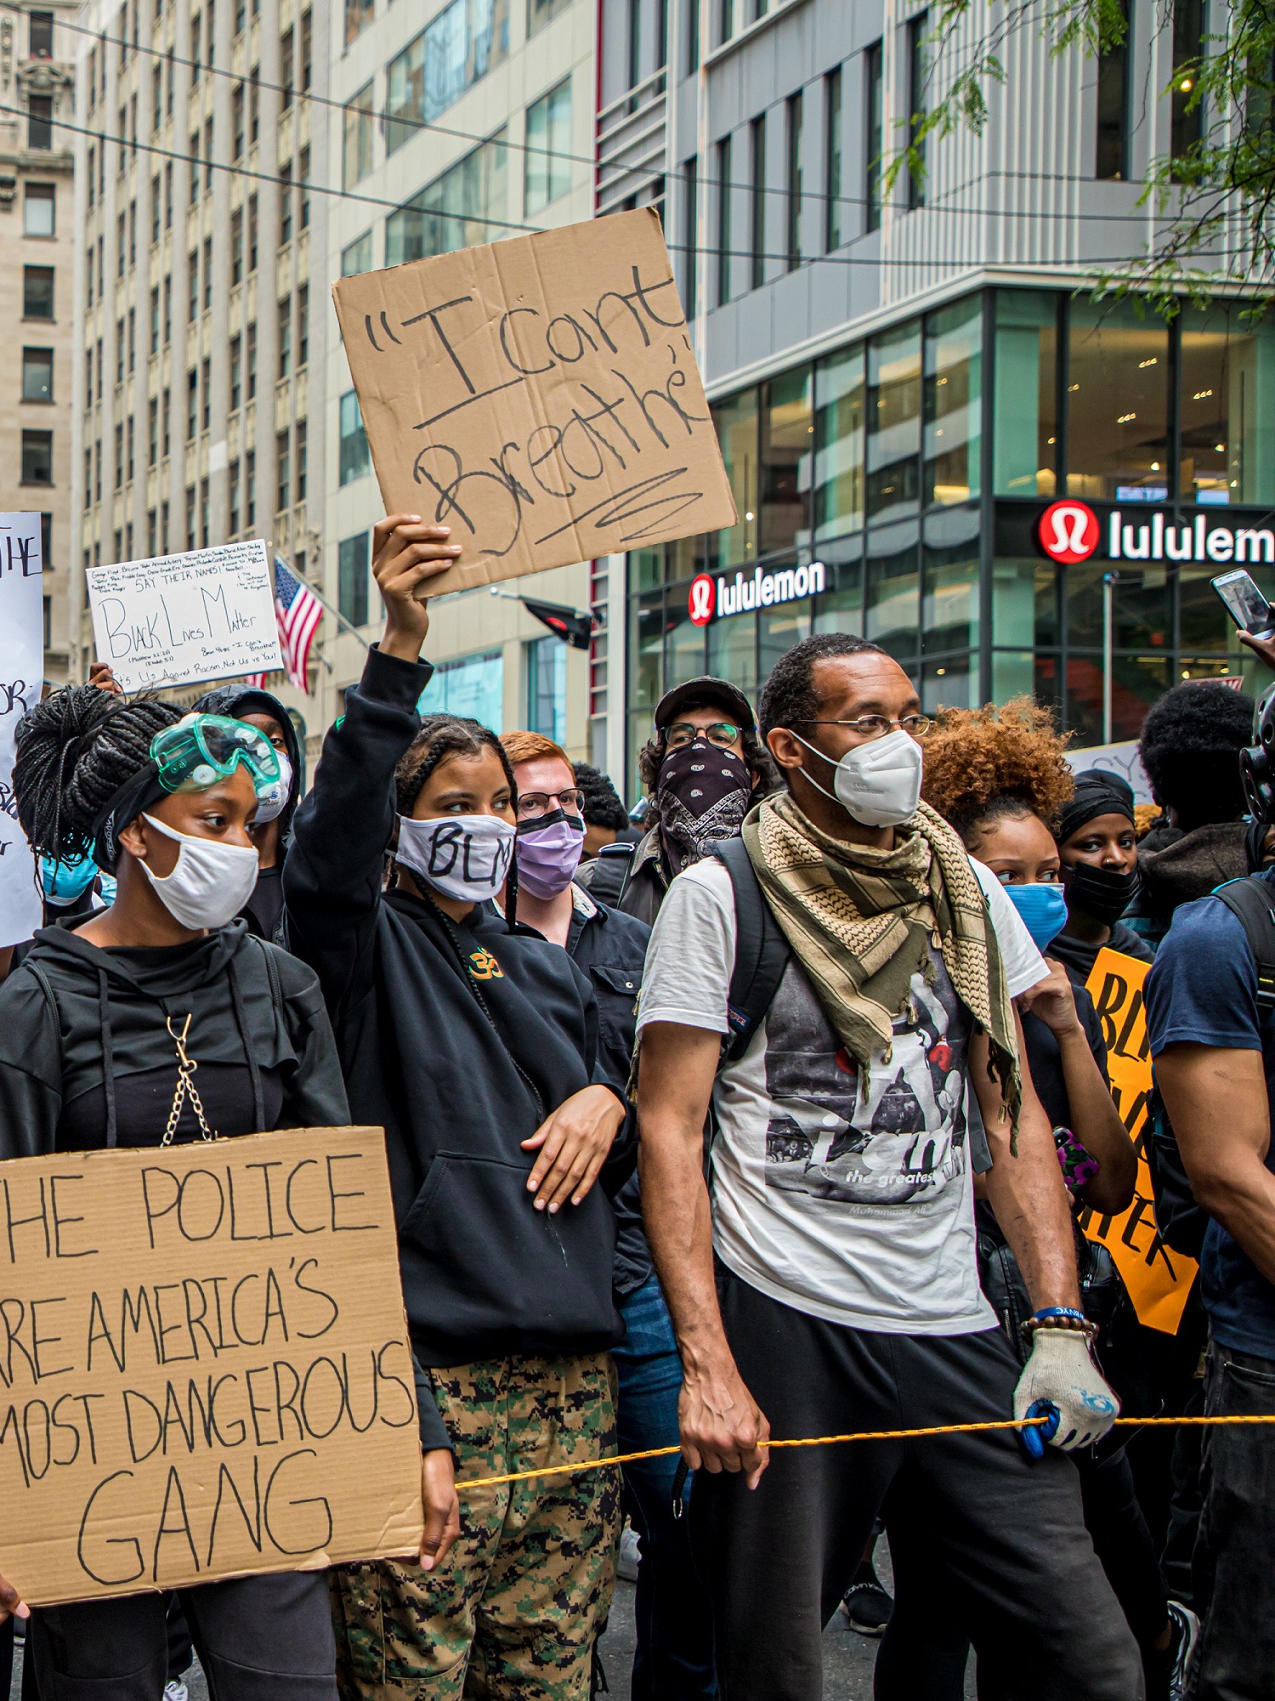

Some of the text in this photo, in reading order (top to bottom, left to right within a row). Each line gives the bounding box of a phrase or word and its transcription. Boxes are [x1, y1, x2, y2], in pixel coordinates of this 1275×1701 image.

[136, 577, 156, 593] SAY
[161, 571, 192, 585] THEIR
[718, 561, 825, 617] lululemon
[427, 821, 512, 888] BLM
[141, 1153, 381, 1249] POLICE
[846, 1169, 936, 1188] the greates
[87, 1257, 339, 1373] AMERICA'S
[122, 1341, 415, 1464] DANGEROUS
[77, 1449, 333, 1586] GANG
